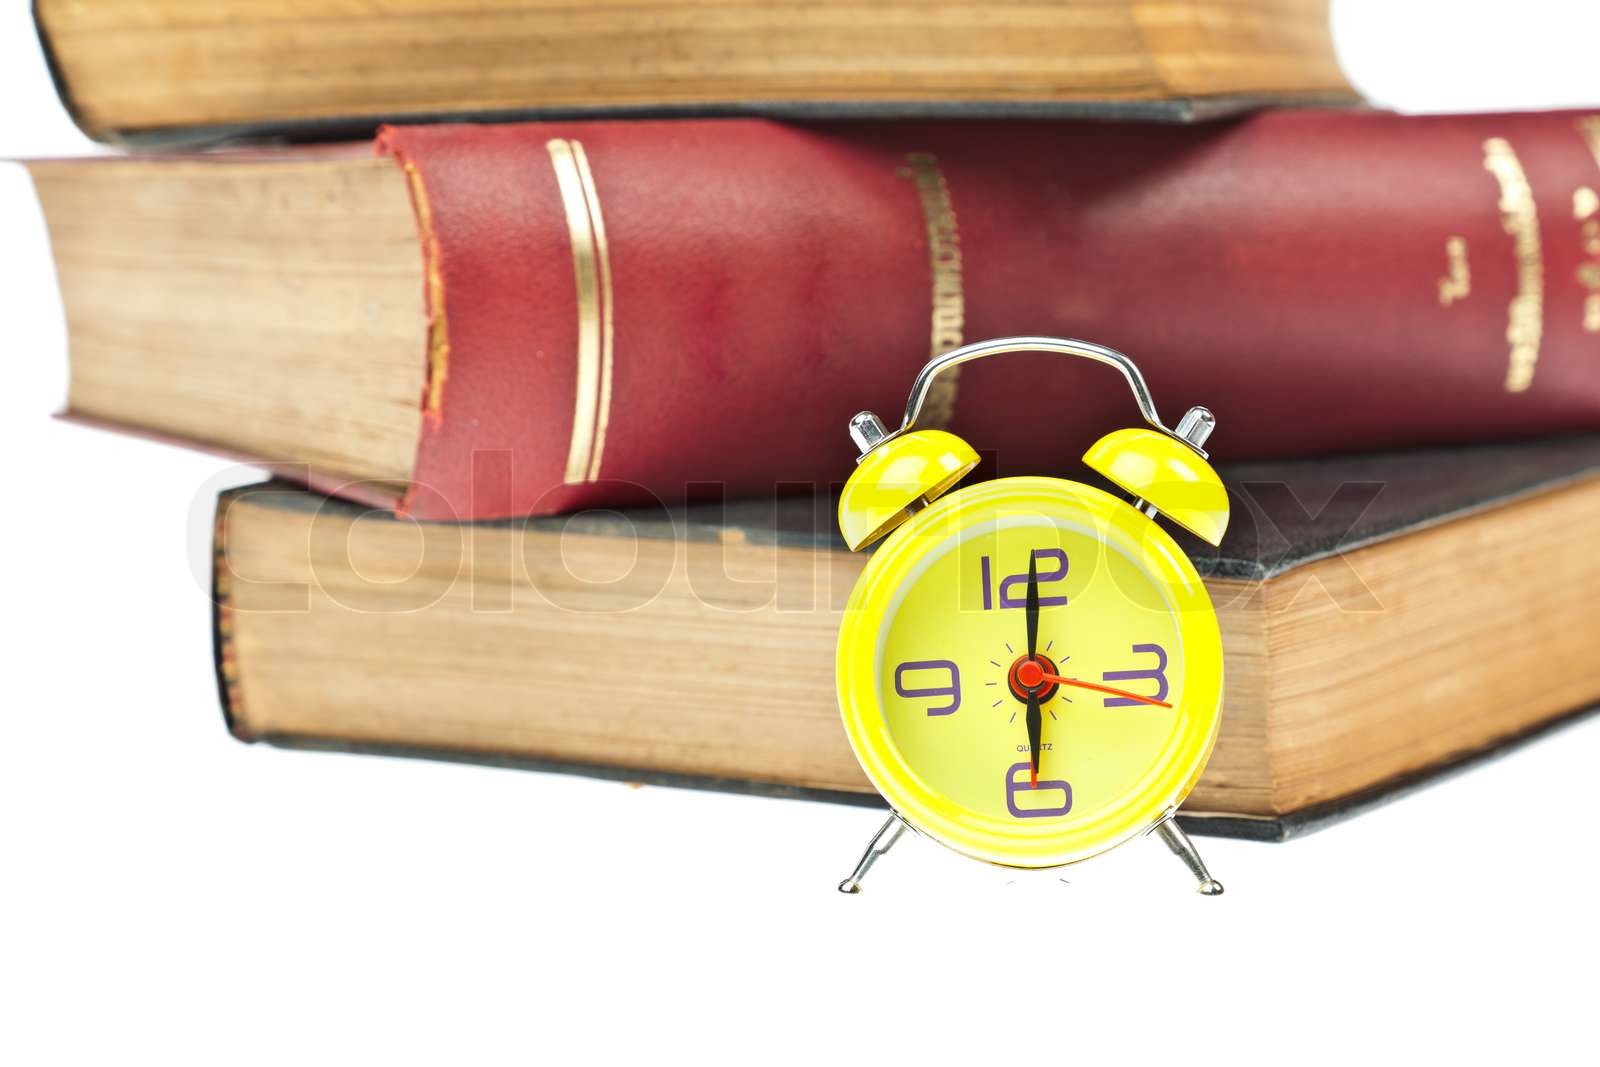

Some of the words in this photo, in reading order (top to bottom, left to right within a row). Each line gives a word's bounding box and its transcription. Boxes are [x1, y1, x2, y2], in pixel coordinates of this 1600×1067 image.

[981, 548, 1069, 610] 12
[895, 660, 961, 717] 9
[1103, 643, 1169, 708] 3
[1016, 743, 1053, 753] QUTZ
[1005, 761, 1073, 818] 6
